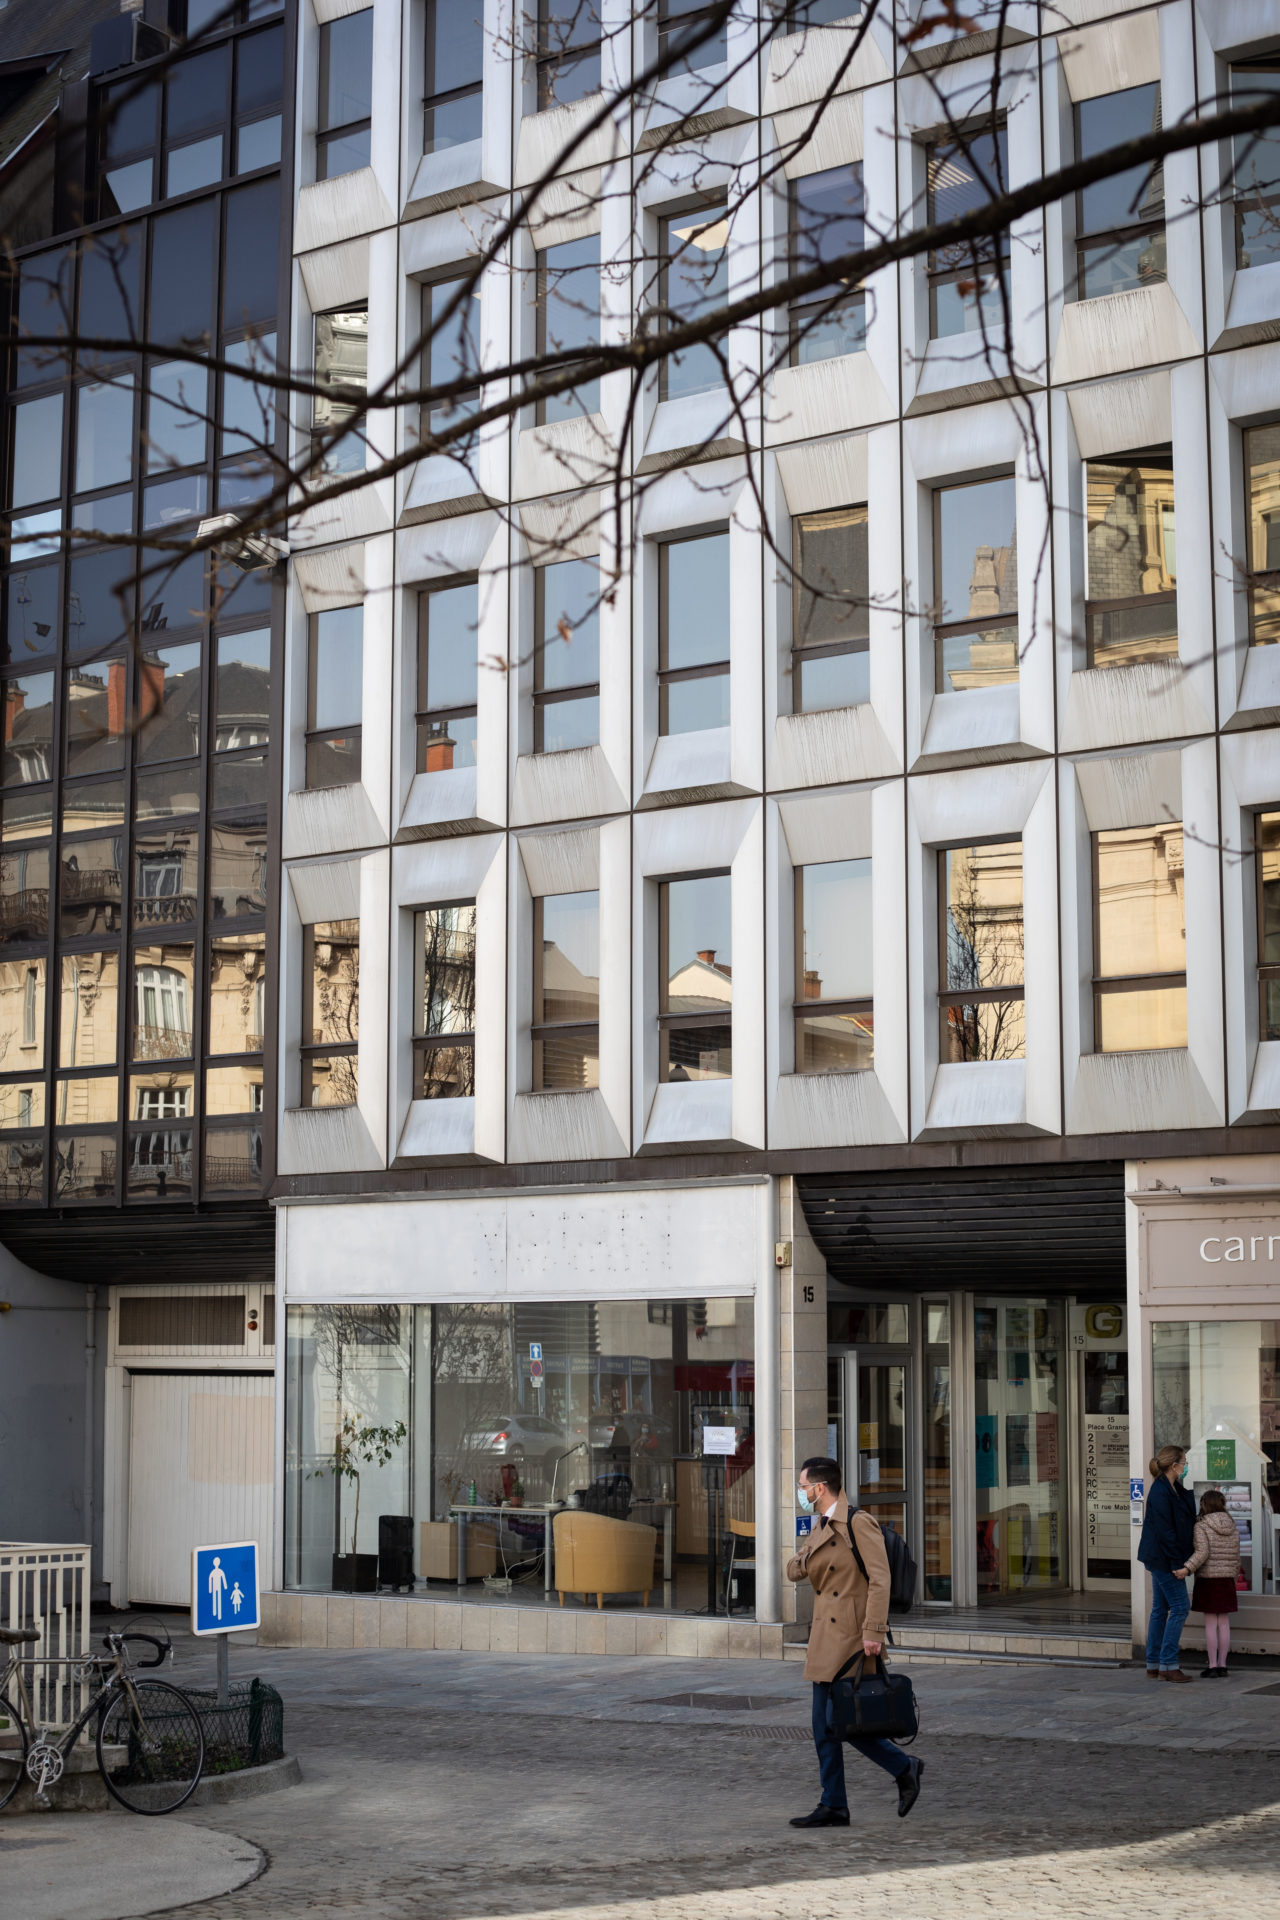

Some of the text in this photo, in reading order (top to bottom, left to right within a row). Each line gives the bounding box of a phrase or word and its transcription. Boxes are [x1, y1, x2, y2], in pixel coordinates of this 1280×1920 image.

[803, 1286, 814, 1303] 15
[1085, 1304, 1123, 1338] G
[1073, 1335, 1084, 1344] 15
[1087, 1433, 1094, 1442] 2
[1088, 1444, 1094, 1454] 2
[1088, 1455, 1095, 1465] 2
[1086, 1468, 1097, 1477] RC
[1087, 1479, 1097, 1488] RC
[1087, 1491, 1097, 1499] RC
[1089, 1513, 1096, 1523] 3
[1089, 1525, 1096, 1534] 2
[1091, 1536, 1095, 1545] 1
